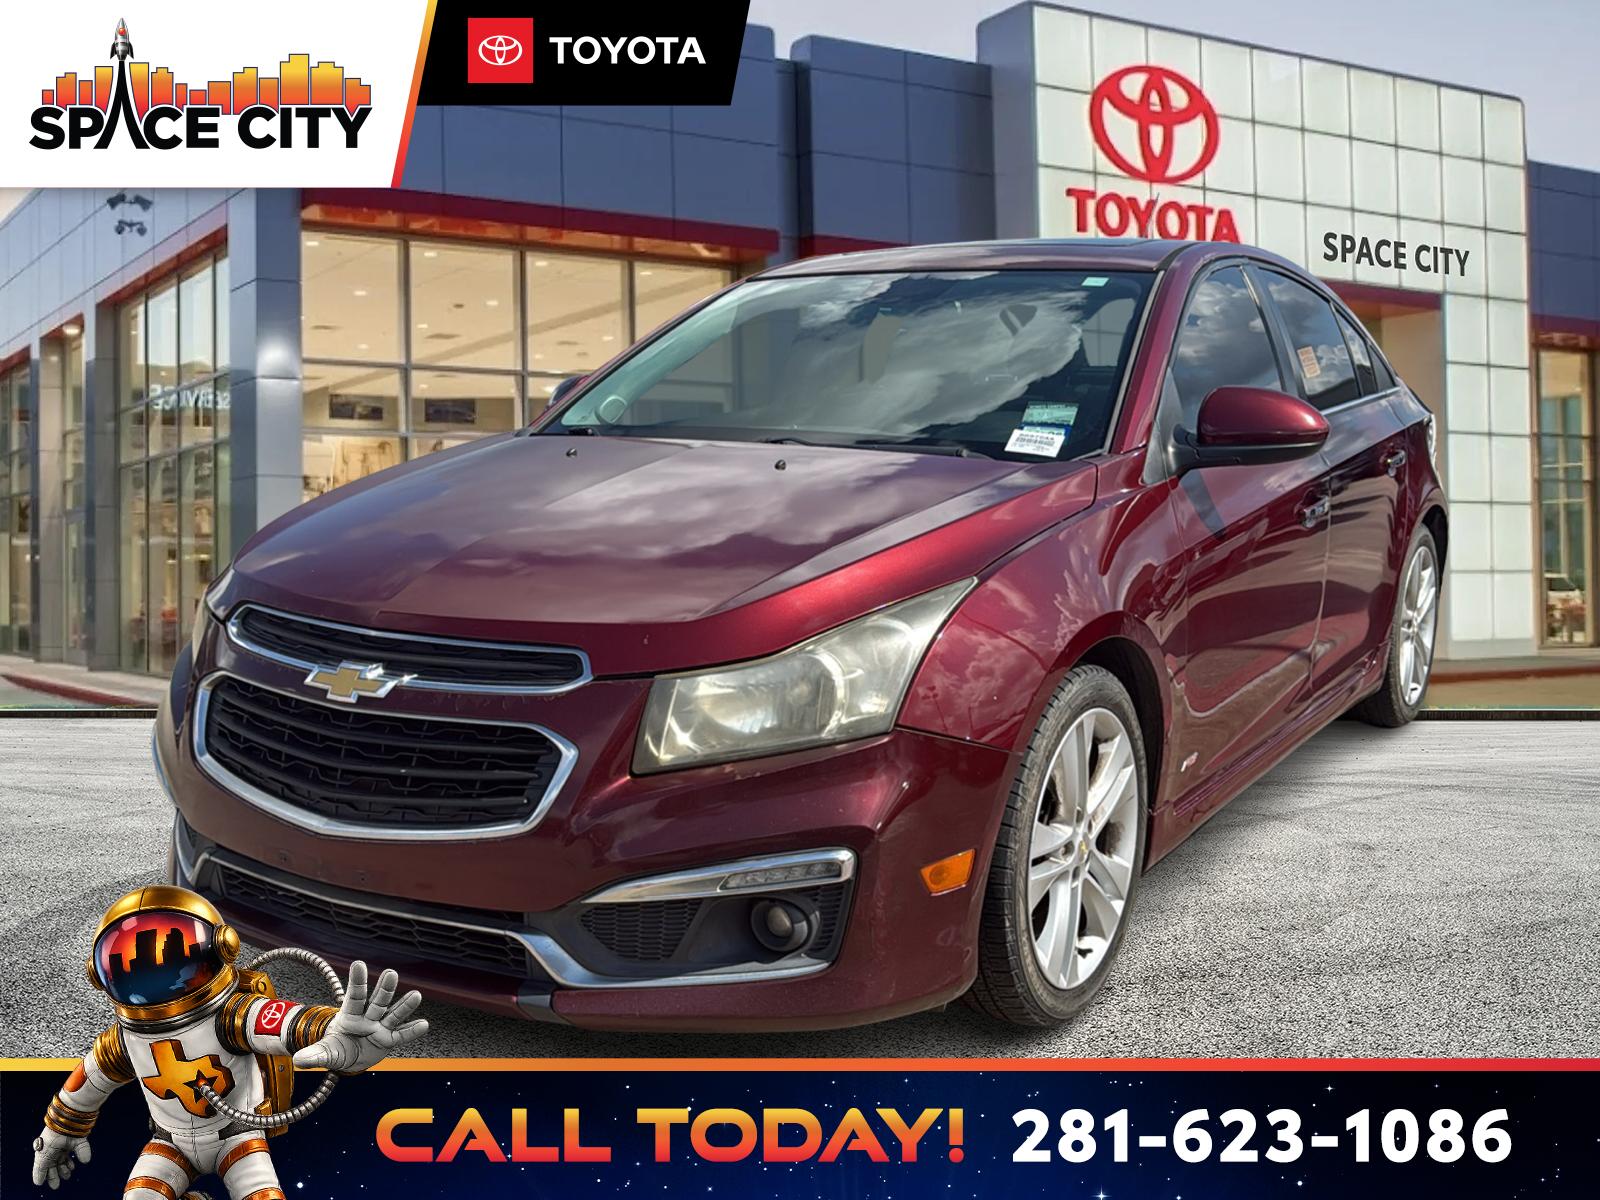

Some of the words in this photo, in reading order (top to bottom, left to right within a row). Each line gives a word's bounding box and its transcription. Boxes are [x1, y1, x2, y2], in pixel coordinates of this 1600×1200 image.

[1066, 188, 1242, 244] TOYOTA
[1323, 232, 1407, 270] SPACE
[1414, 244, 1470, 277] CITY
